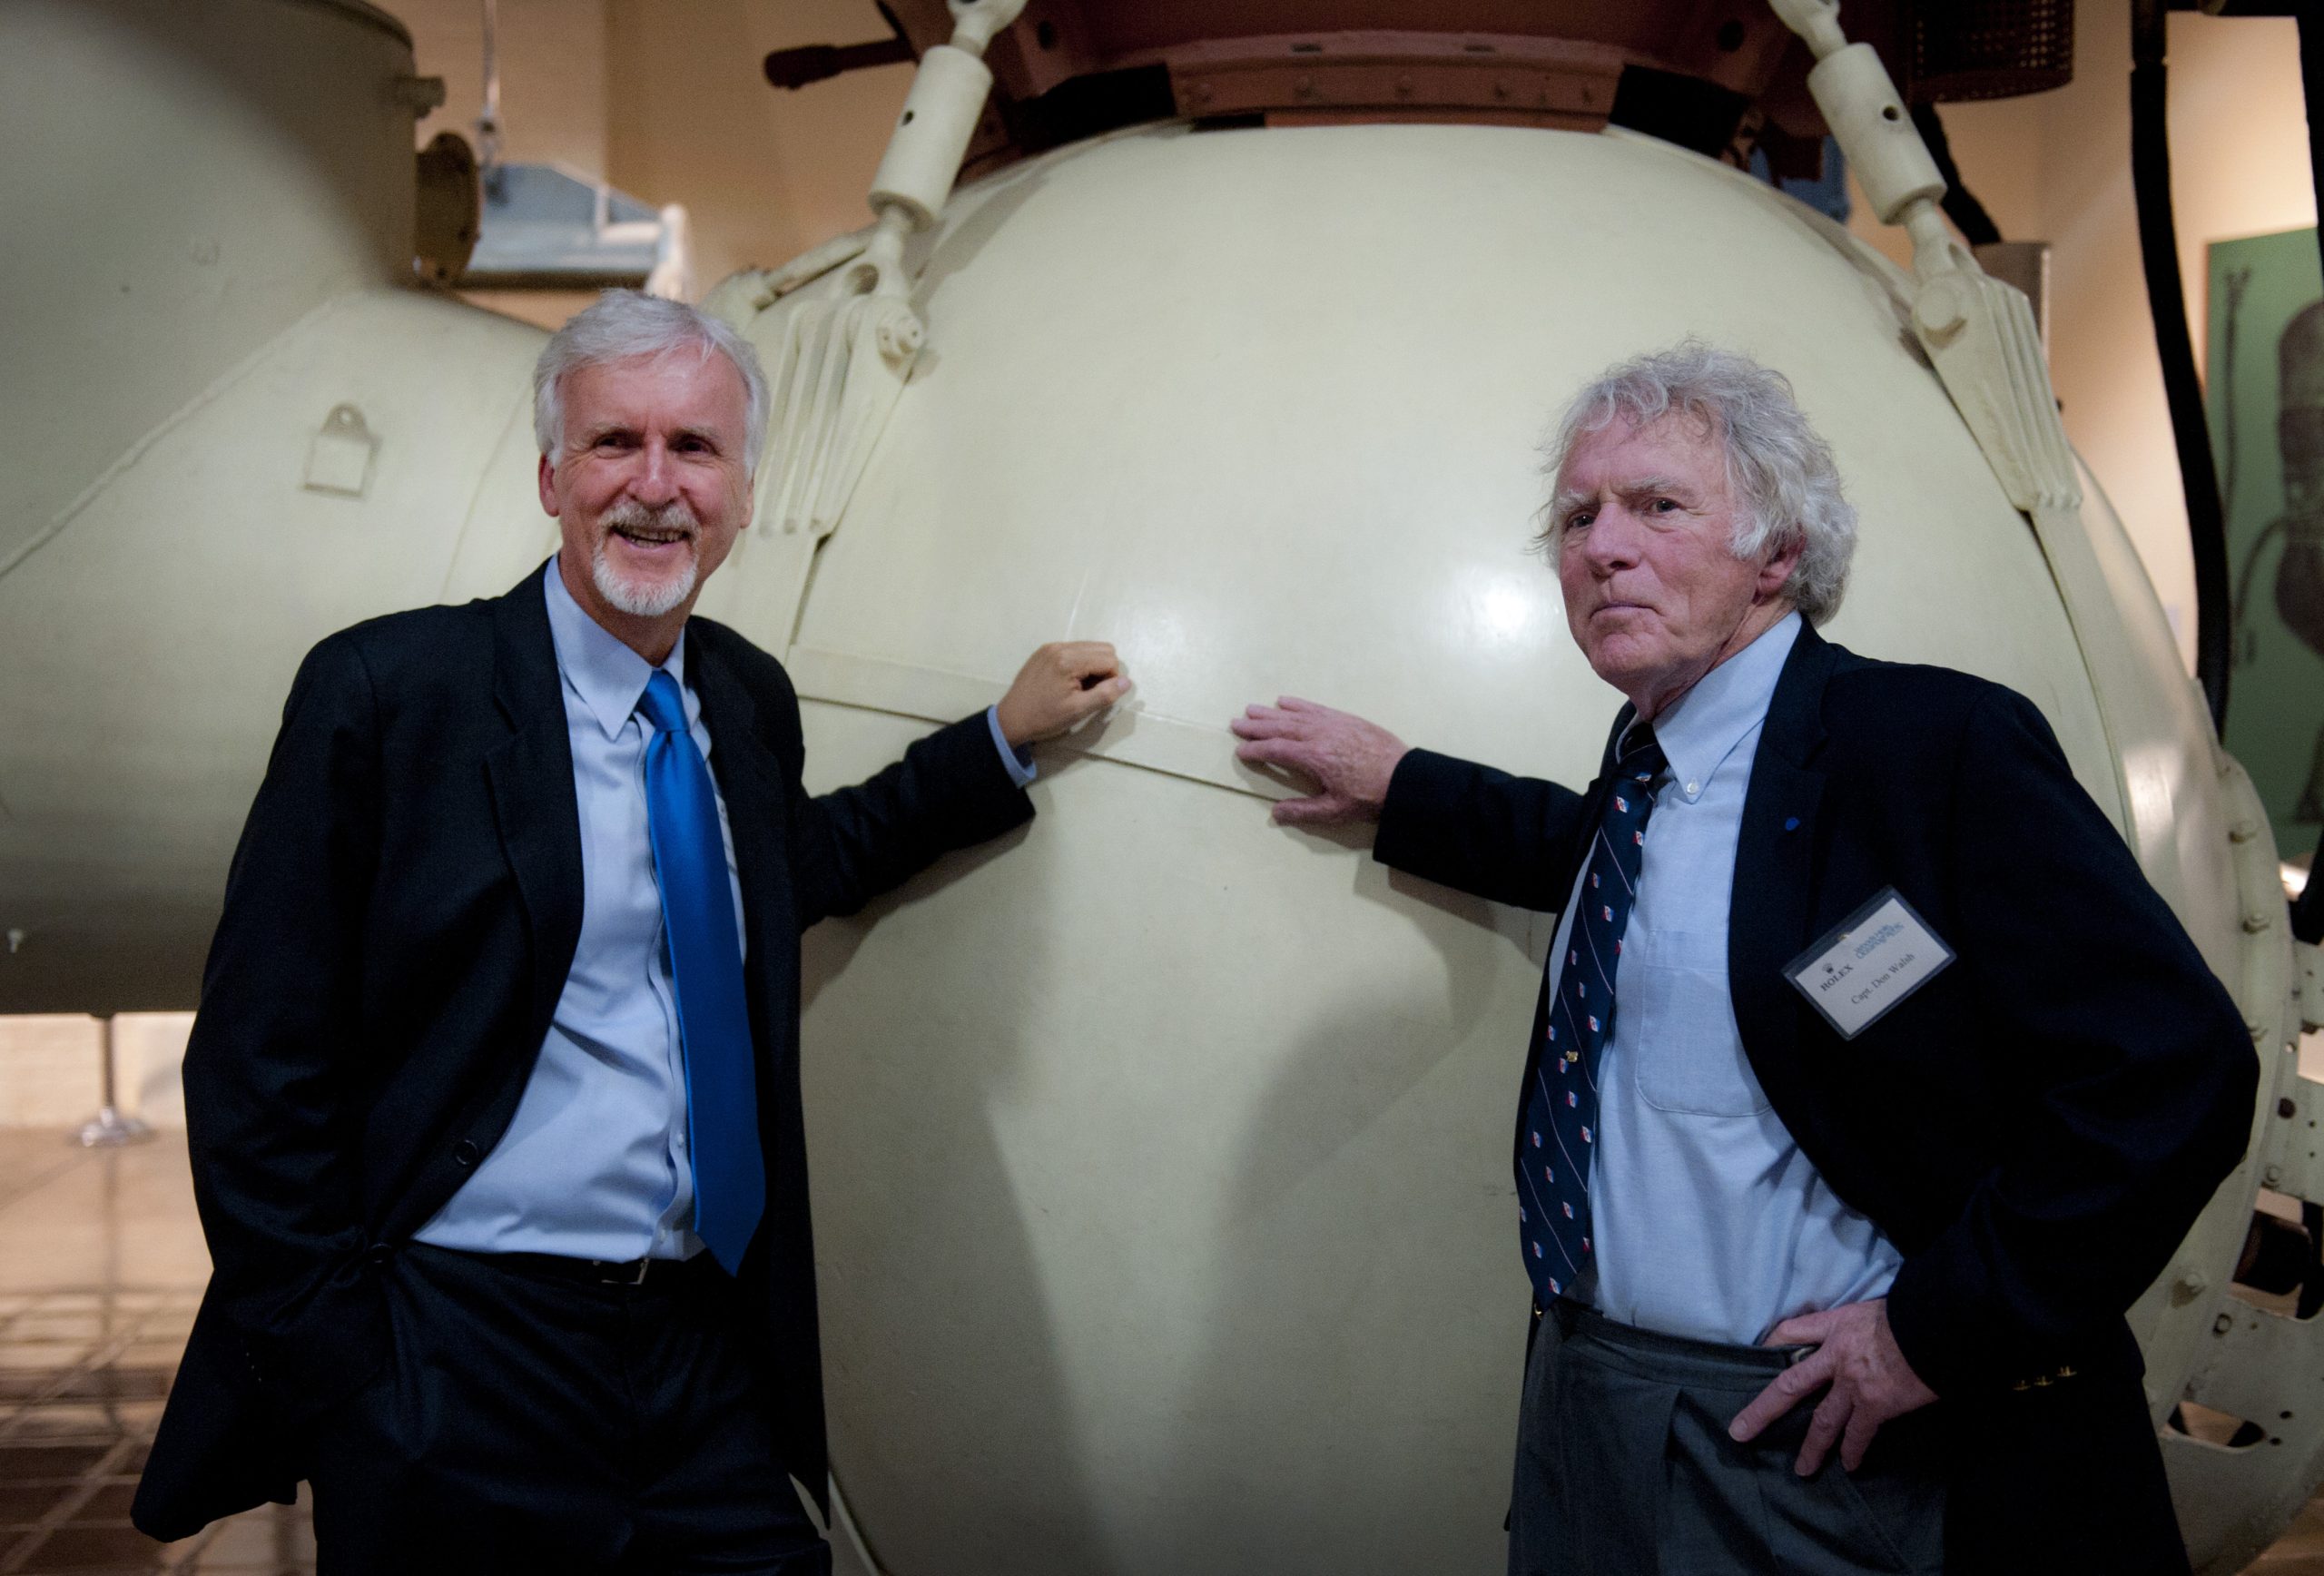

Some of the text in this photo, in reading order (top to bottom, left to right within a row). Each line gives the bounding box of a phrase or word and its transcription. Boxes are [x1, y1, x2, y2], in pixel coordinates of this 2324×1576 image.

[1820, 963, 1854, 991] ROLEX
[1852, 953, 1915, 1004] Capt. Don Walsh
